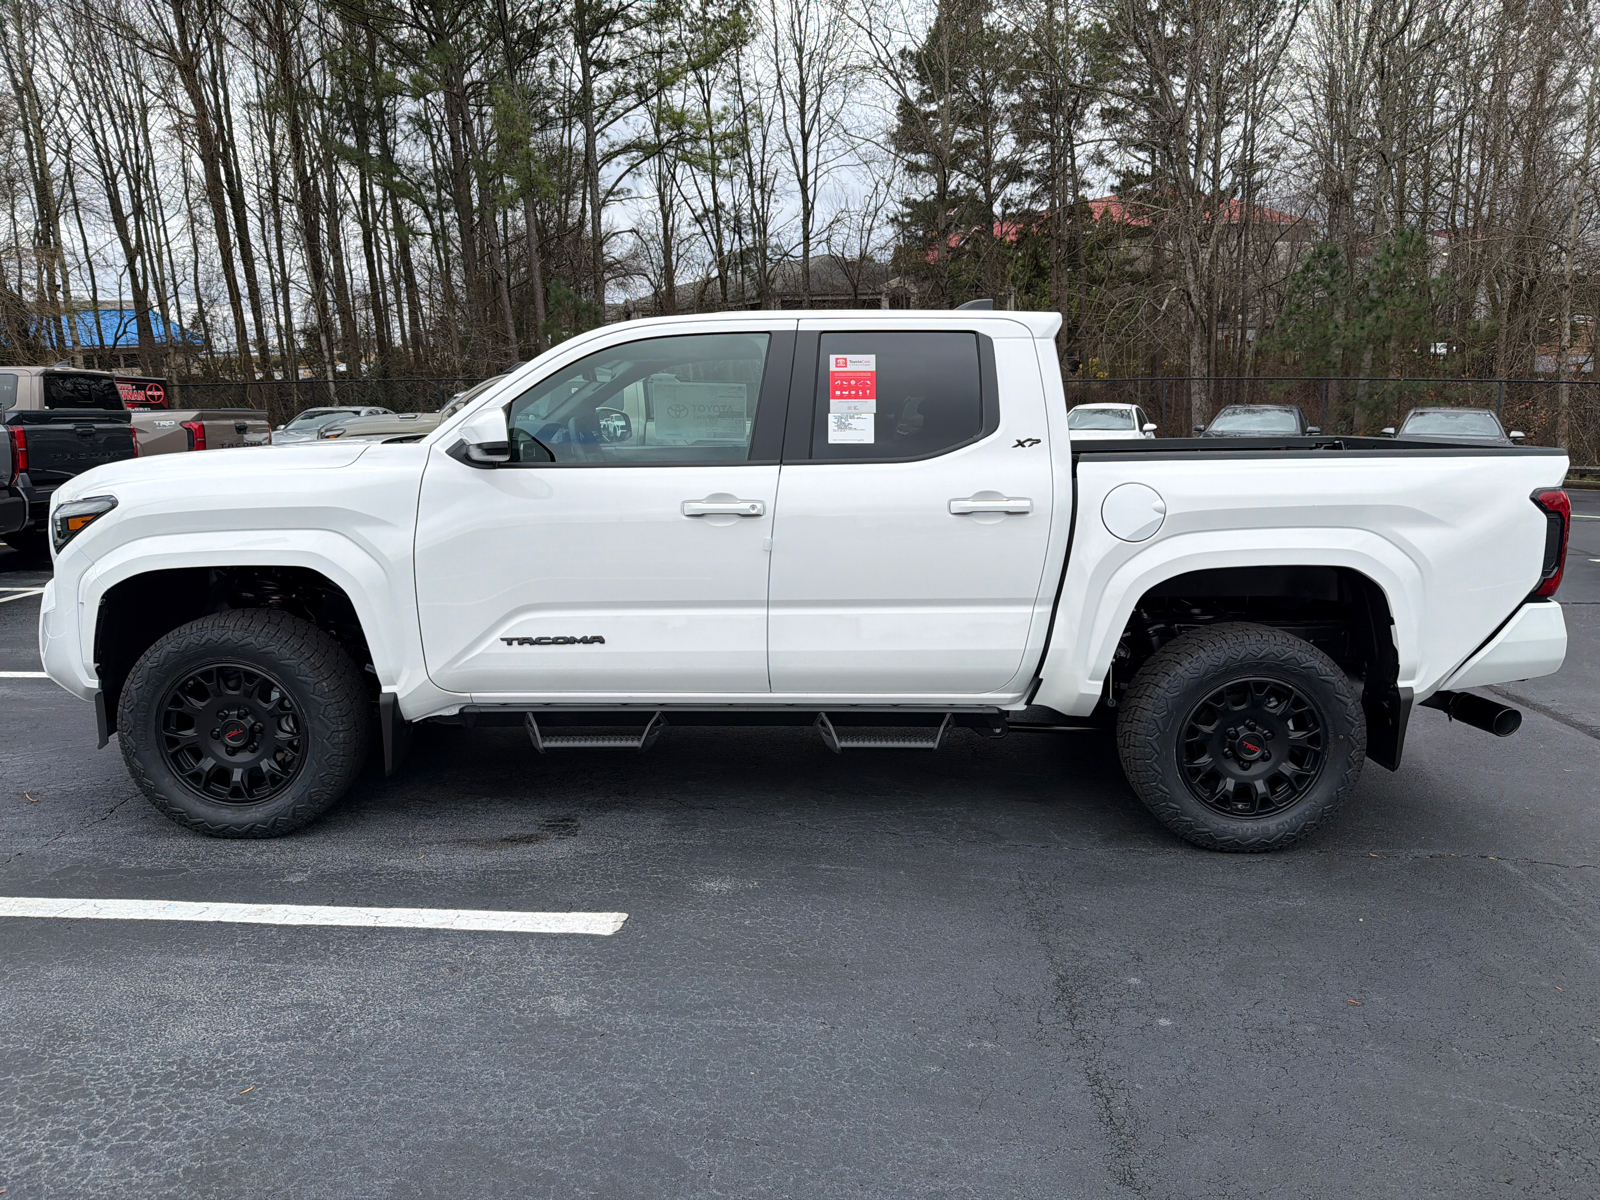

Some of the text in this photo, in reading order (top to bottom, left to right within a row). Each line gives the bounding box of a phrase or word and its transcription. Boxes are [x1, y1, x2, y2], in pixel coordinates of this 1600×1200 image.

[691, 404, 733, 413] TOYOTA
[1011, 438, 1042, 448] XP
[49, 452, 121, 461] TACOMA
[499, 635, 606, 646] TACOMA
[225, 728, 244, 739] TRD
[1242, 741, 1260, 752] TRD
